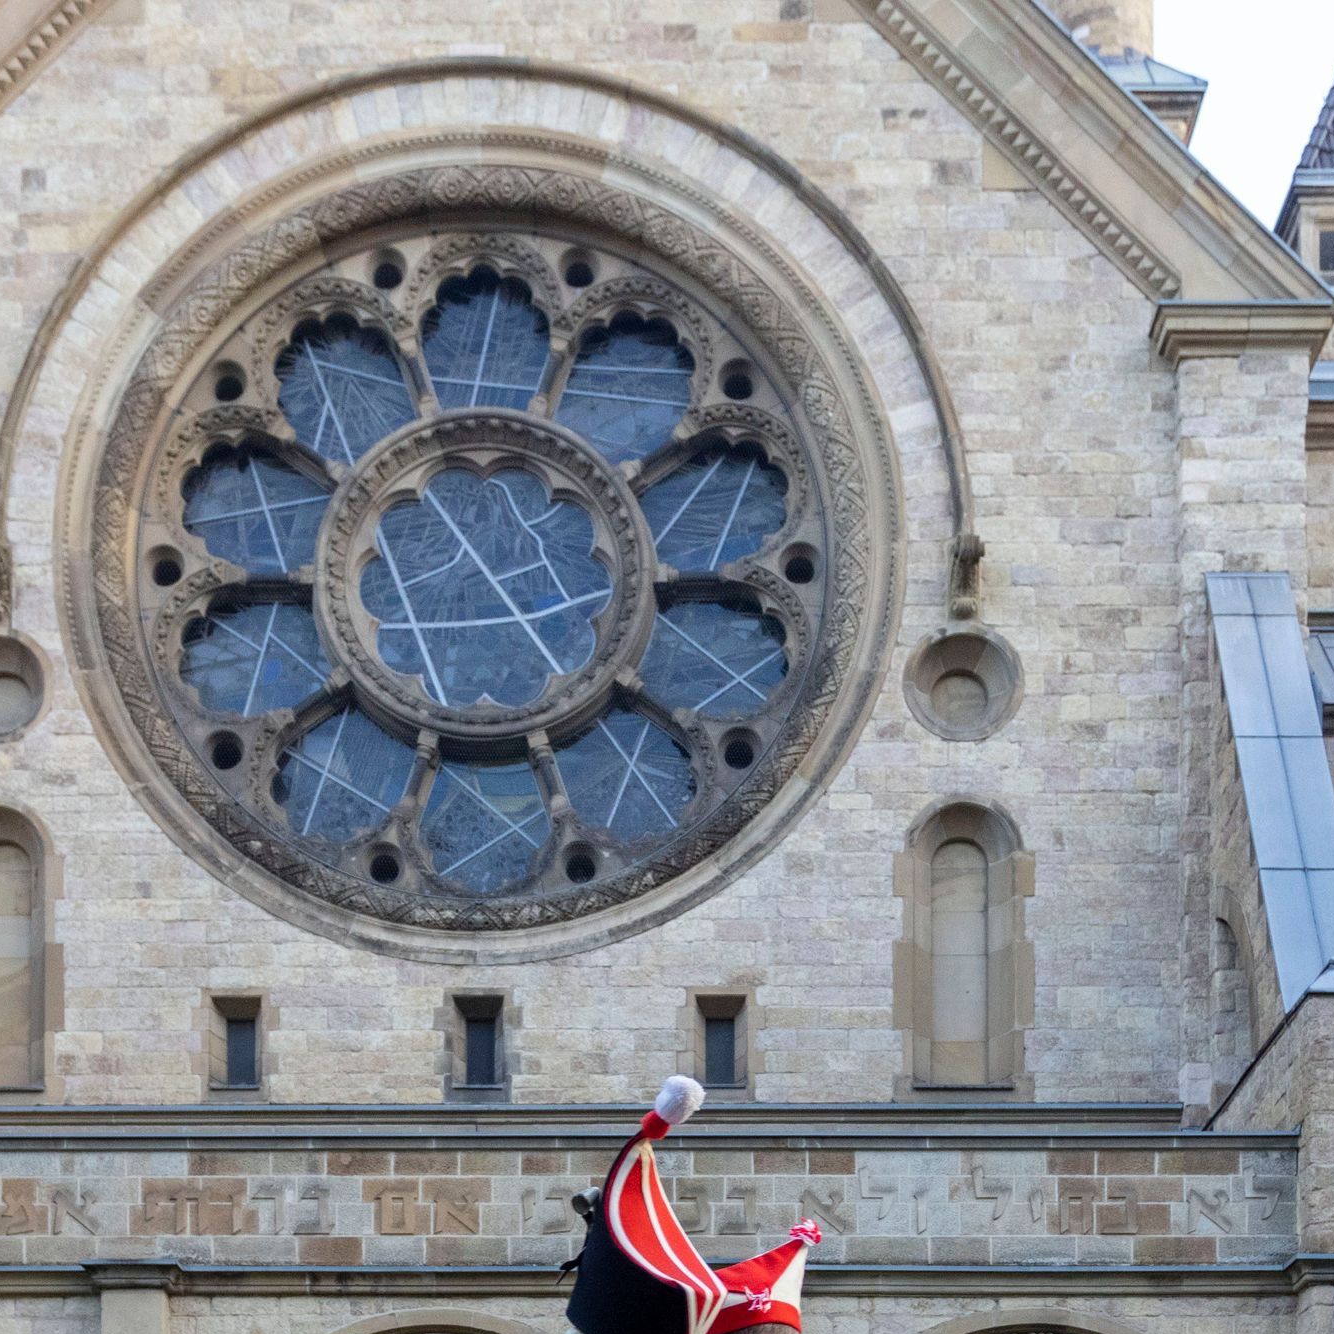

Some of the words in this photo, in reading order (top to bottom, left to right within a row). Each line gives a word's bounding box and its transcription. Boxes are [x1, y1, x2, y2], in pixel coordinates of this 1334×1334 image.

[143, 1185, 336, 1236] ברוחי
[373, 1187, 479, 1236] אם
[677, 1186, 760, 1235] בכ
[798, 1165, 930, 1235] ולא
[970, 1165, 1140, 1235] בחיל
[1186, 1163, 1283, 1234] לא
